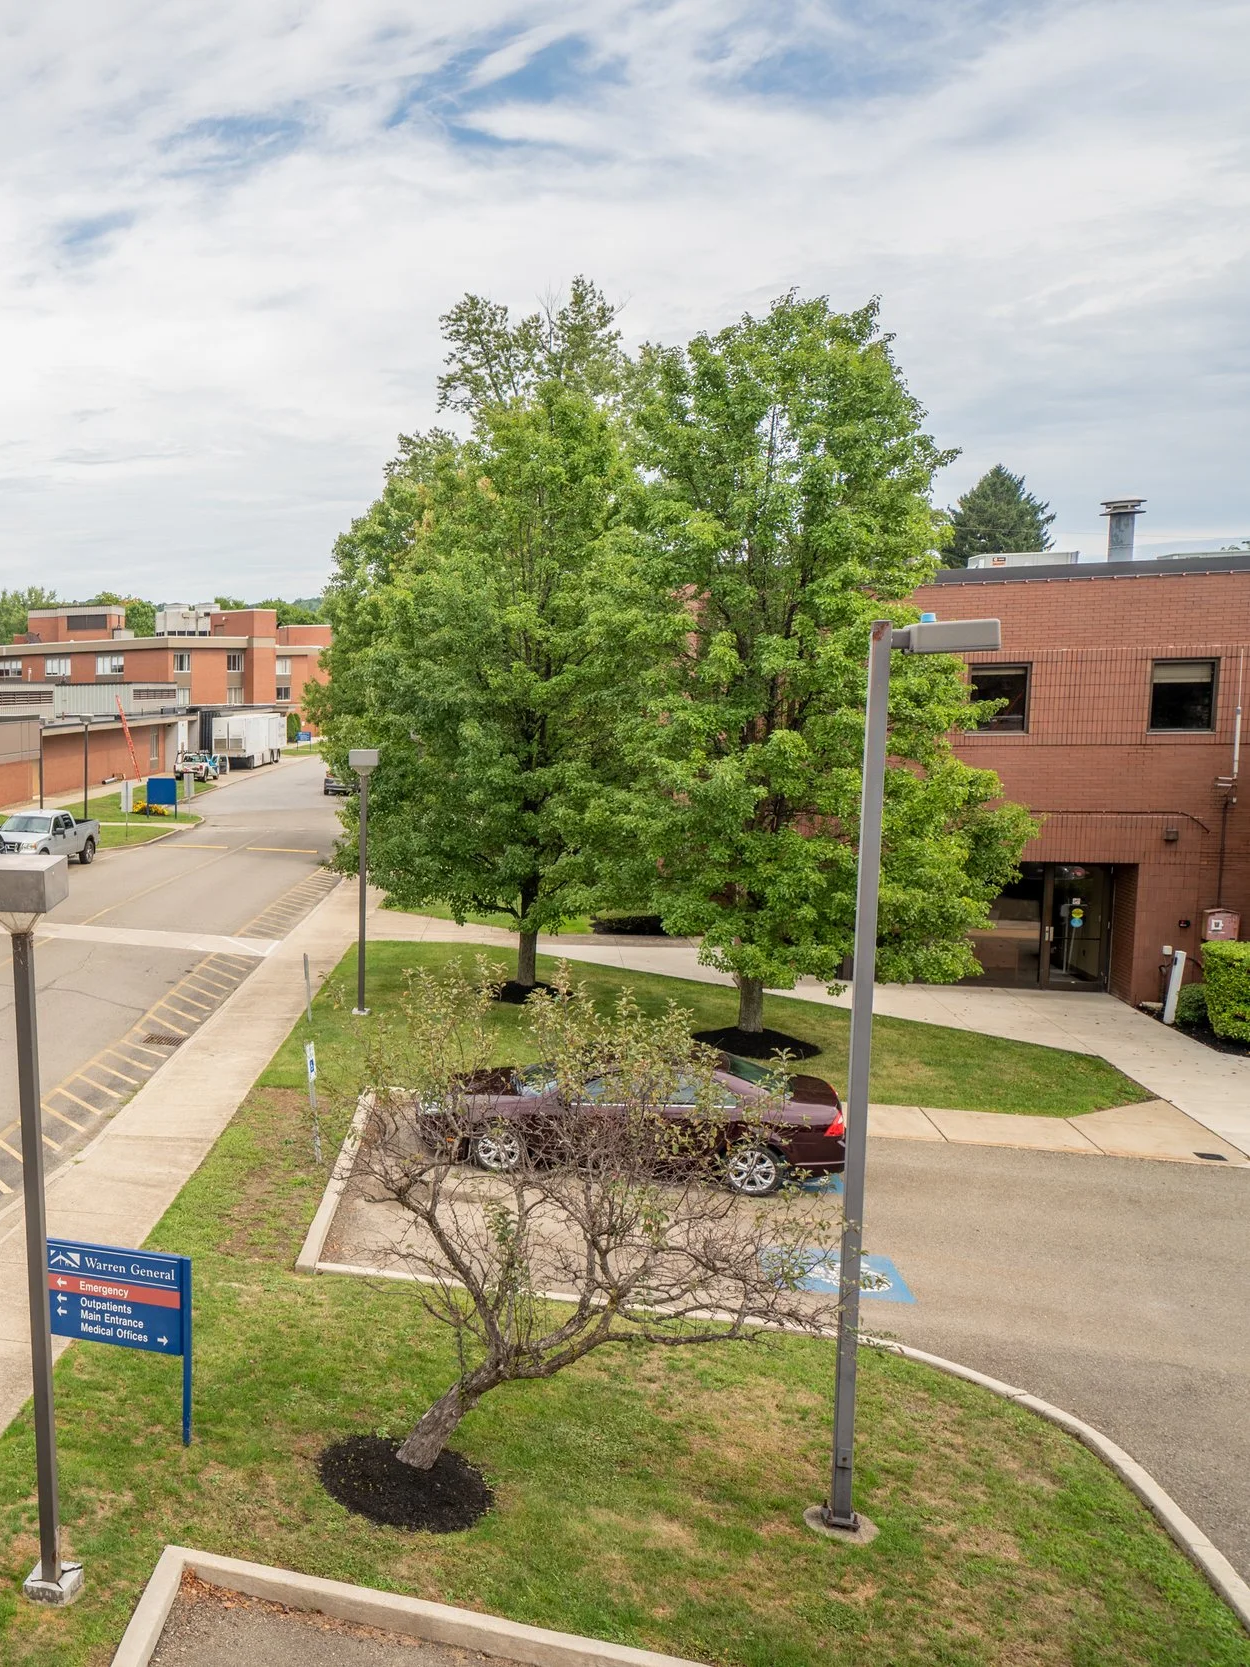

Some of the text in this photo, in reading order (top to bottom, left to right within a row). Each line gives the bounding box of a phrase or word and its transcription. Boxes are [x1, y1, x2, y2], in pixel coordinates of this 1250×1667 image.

[84, 1256, 175, 1281] Warren General
[79, 1280, 129, 1298] Emergency
[80, 1296, 132, 1315] Outpatients
[80, 1309, 144, 1329] Main Entrance
[80, 1322, 149, 1343] Medical Offices
